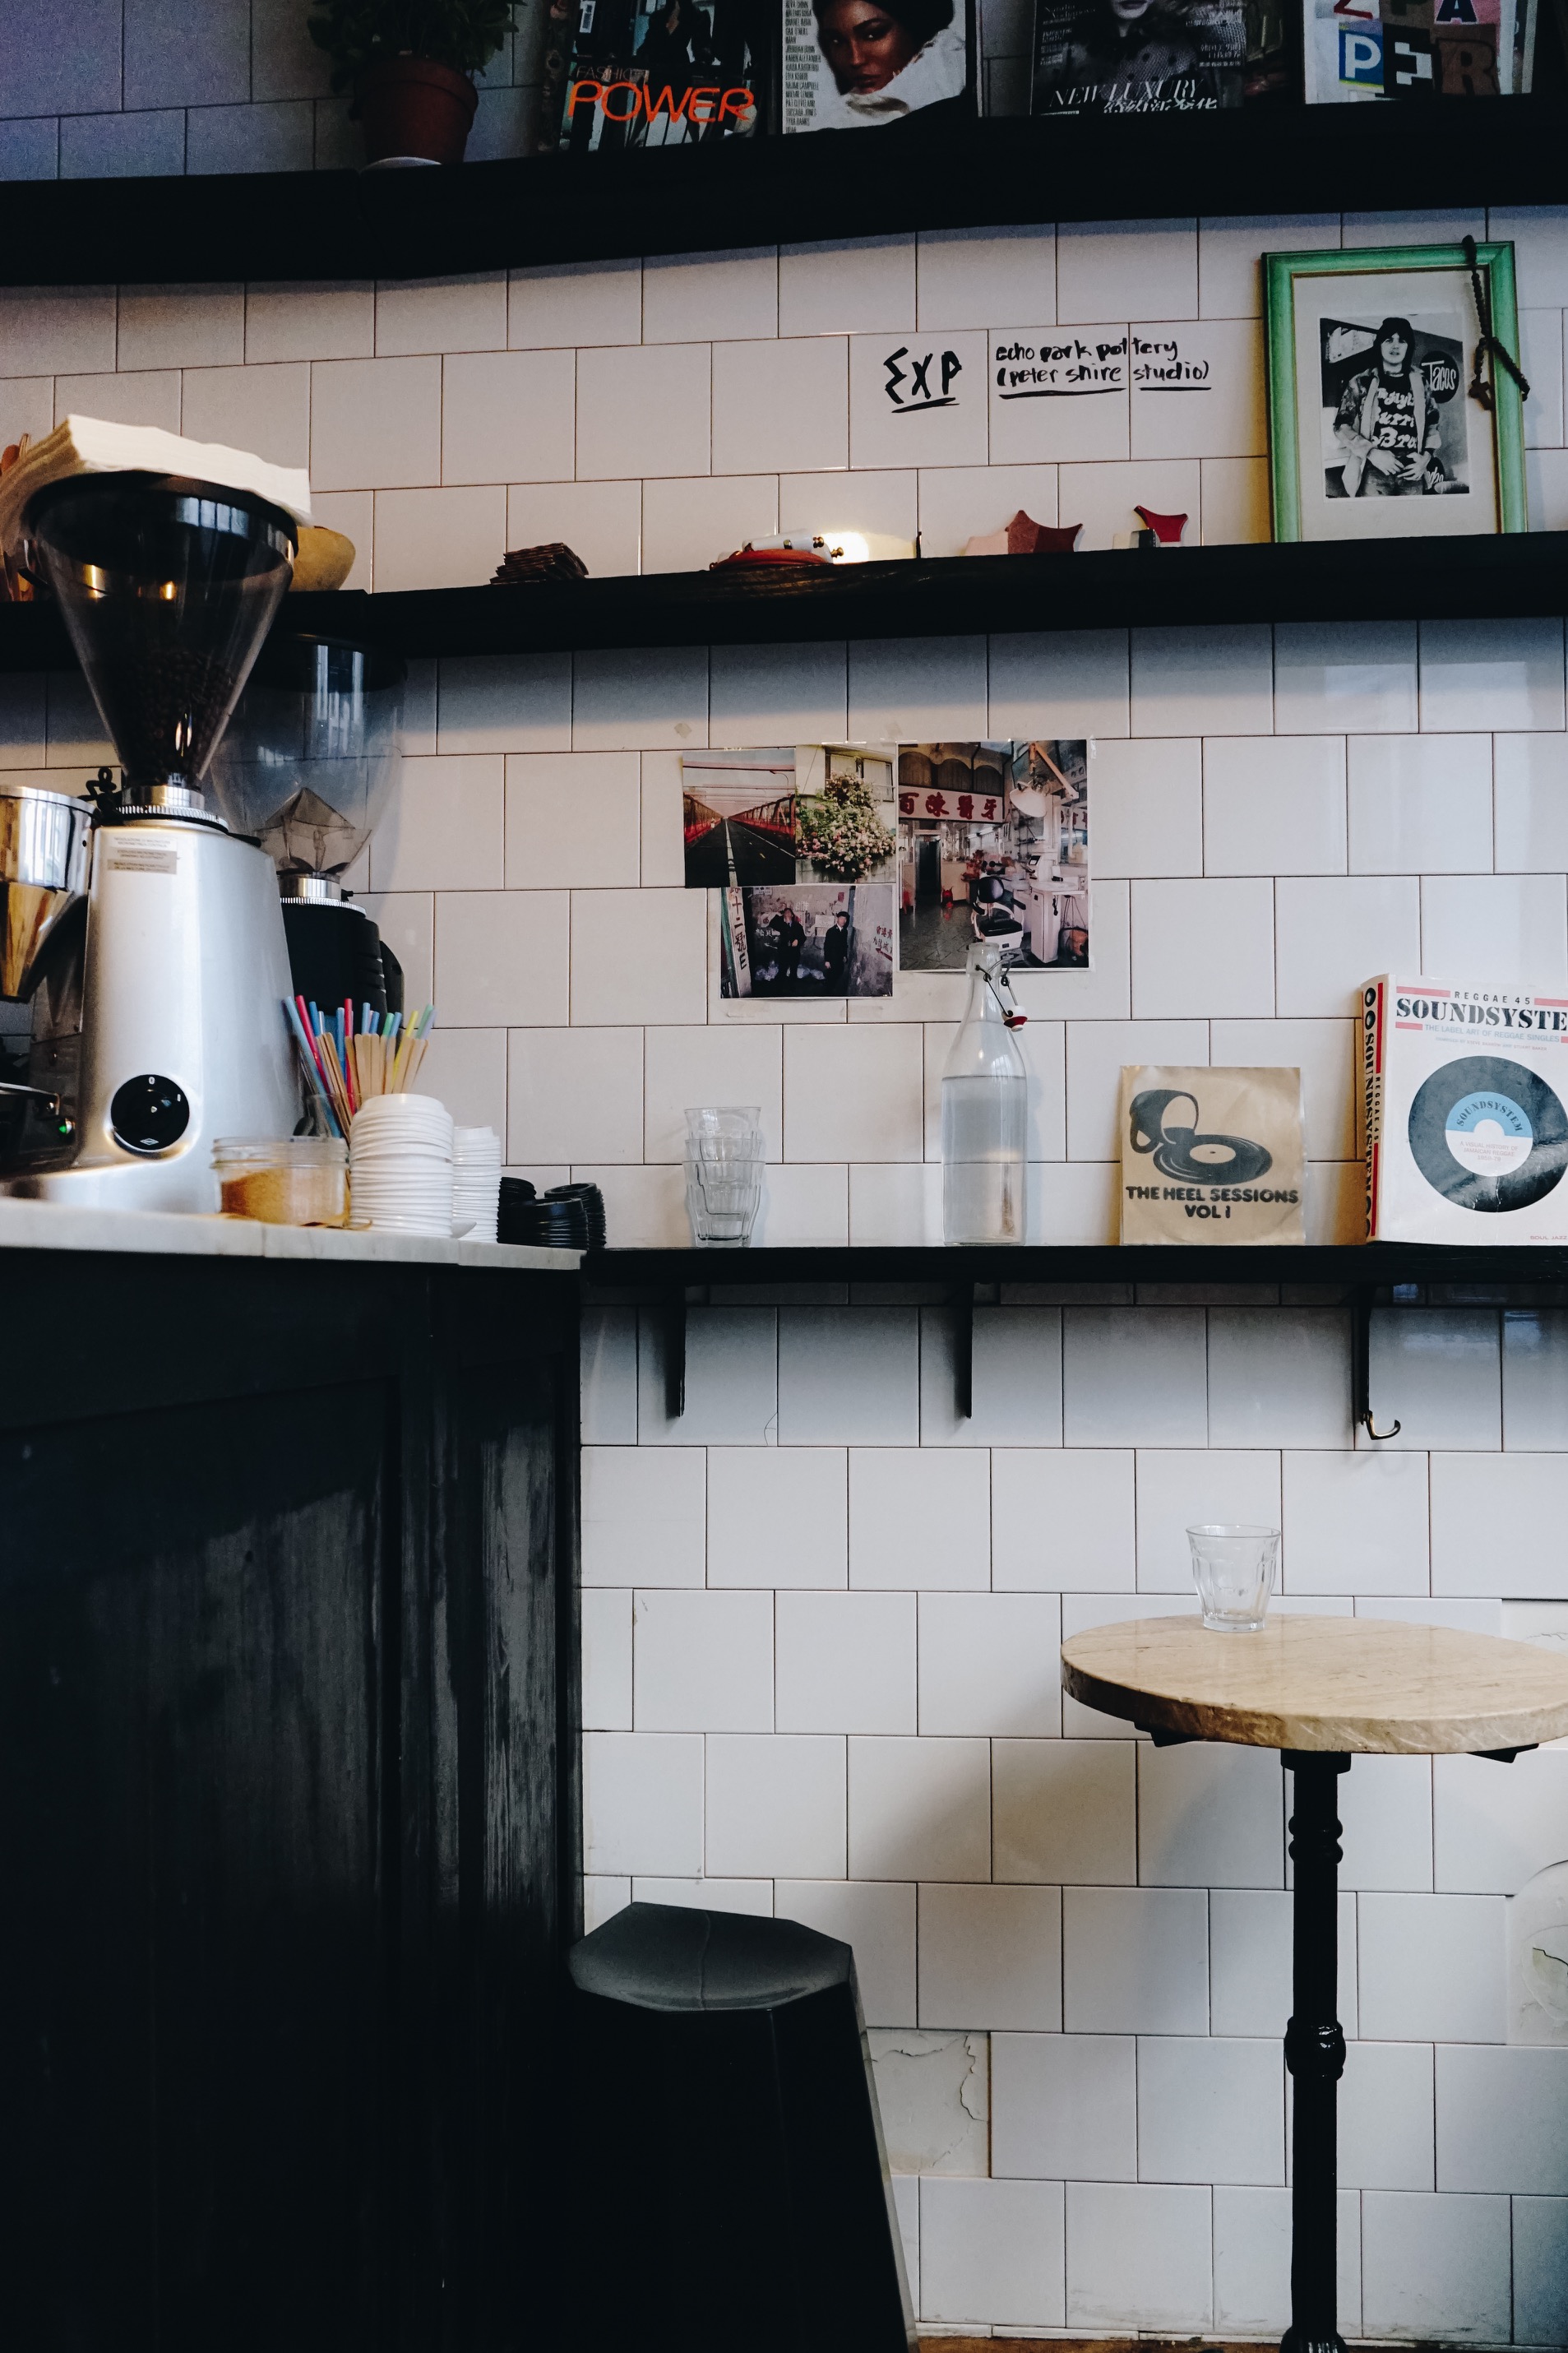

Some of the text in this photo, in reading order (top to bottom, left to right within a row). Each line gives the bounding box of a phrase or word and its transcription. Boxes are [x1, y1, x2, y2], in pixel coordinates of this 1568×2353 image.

[567, 80, 755, 123] POWER
[1050, 79, 1204, 107] NEW LUXURY
[996, 338, 1178, 364] echo park pottery
[883, 347, 963, 404] EXP
[997, 367, 1060, 388] (peter
[1134, 359, 1210, 381] studio)
[1421, 359, 1457, 391] Tacos
[1455, 991, 1531, 1005] REGGAE 45
[1396, 998, 1567, 1031] SOUNDSYSTE
[1425, 1024, 1440, 1032] THE
[1441, 1026, 1464, 1035] LABEL
[1466, 1028, 1480, 1036] ART
[1494, 1031, 1525, 1040] REGGAE
[1527, 1033, 1561, 1043] SINGLES
[1456, 1100, 1523, 1132] SOUNDSYSTEM
[1126, 1186, 1299, 1204] THE HEEL SESSIONS
[1184, 1205, 1222, 1219] VOL
